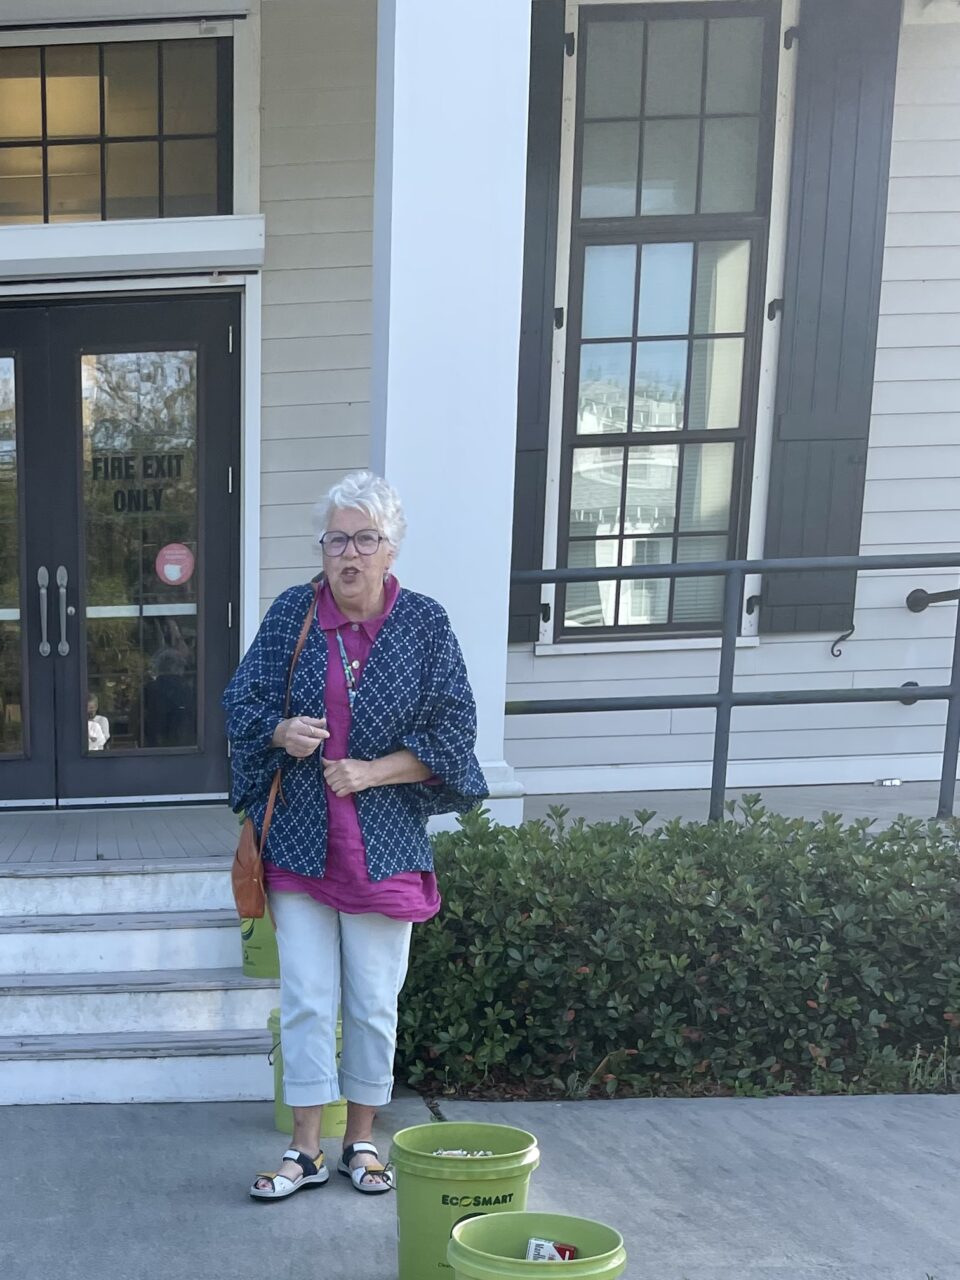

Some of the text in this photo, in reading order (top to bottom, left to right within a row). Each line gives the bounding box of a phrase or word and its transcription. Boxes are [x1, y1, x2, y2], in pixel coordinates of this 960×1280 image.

[92, 454, 184, 480] FIRE EXIT
[114, 488, 163, 512] ONLY
[441, 1193, 514, 1207] ECOSMART
